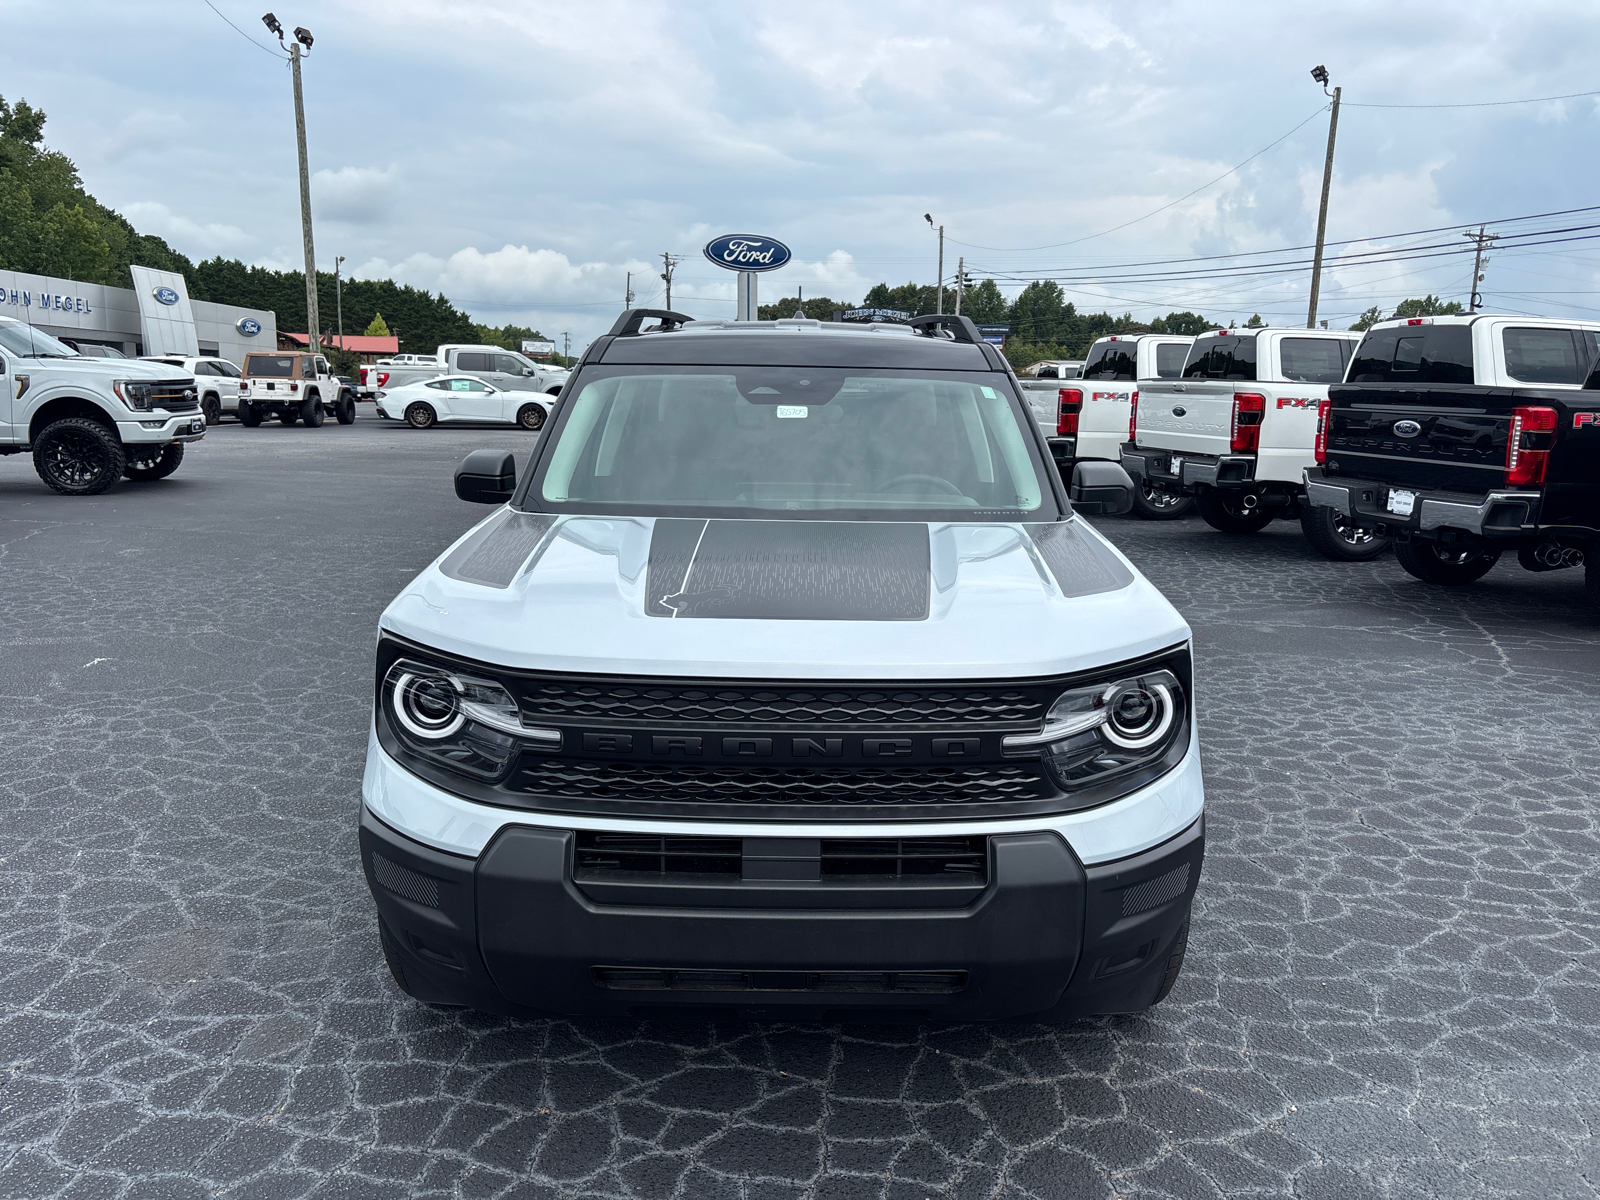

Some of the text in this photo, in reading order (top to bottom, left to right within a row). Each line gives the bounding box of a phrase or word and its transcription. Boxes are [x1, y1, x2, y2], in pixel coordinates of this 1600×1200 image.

[723, 239, 775, 263] Ford
[41, 294, 92, 312] MEGEL
[1092, 391, 1129, 401] FX4
[1276, 397, 1321, 409] FX4
[1139, 418, 1225, 432] SUPER DUTY
[1334, 437, 1411, 452] SUPER
[582, 732, 981, 757] BRONCO
